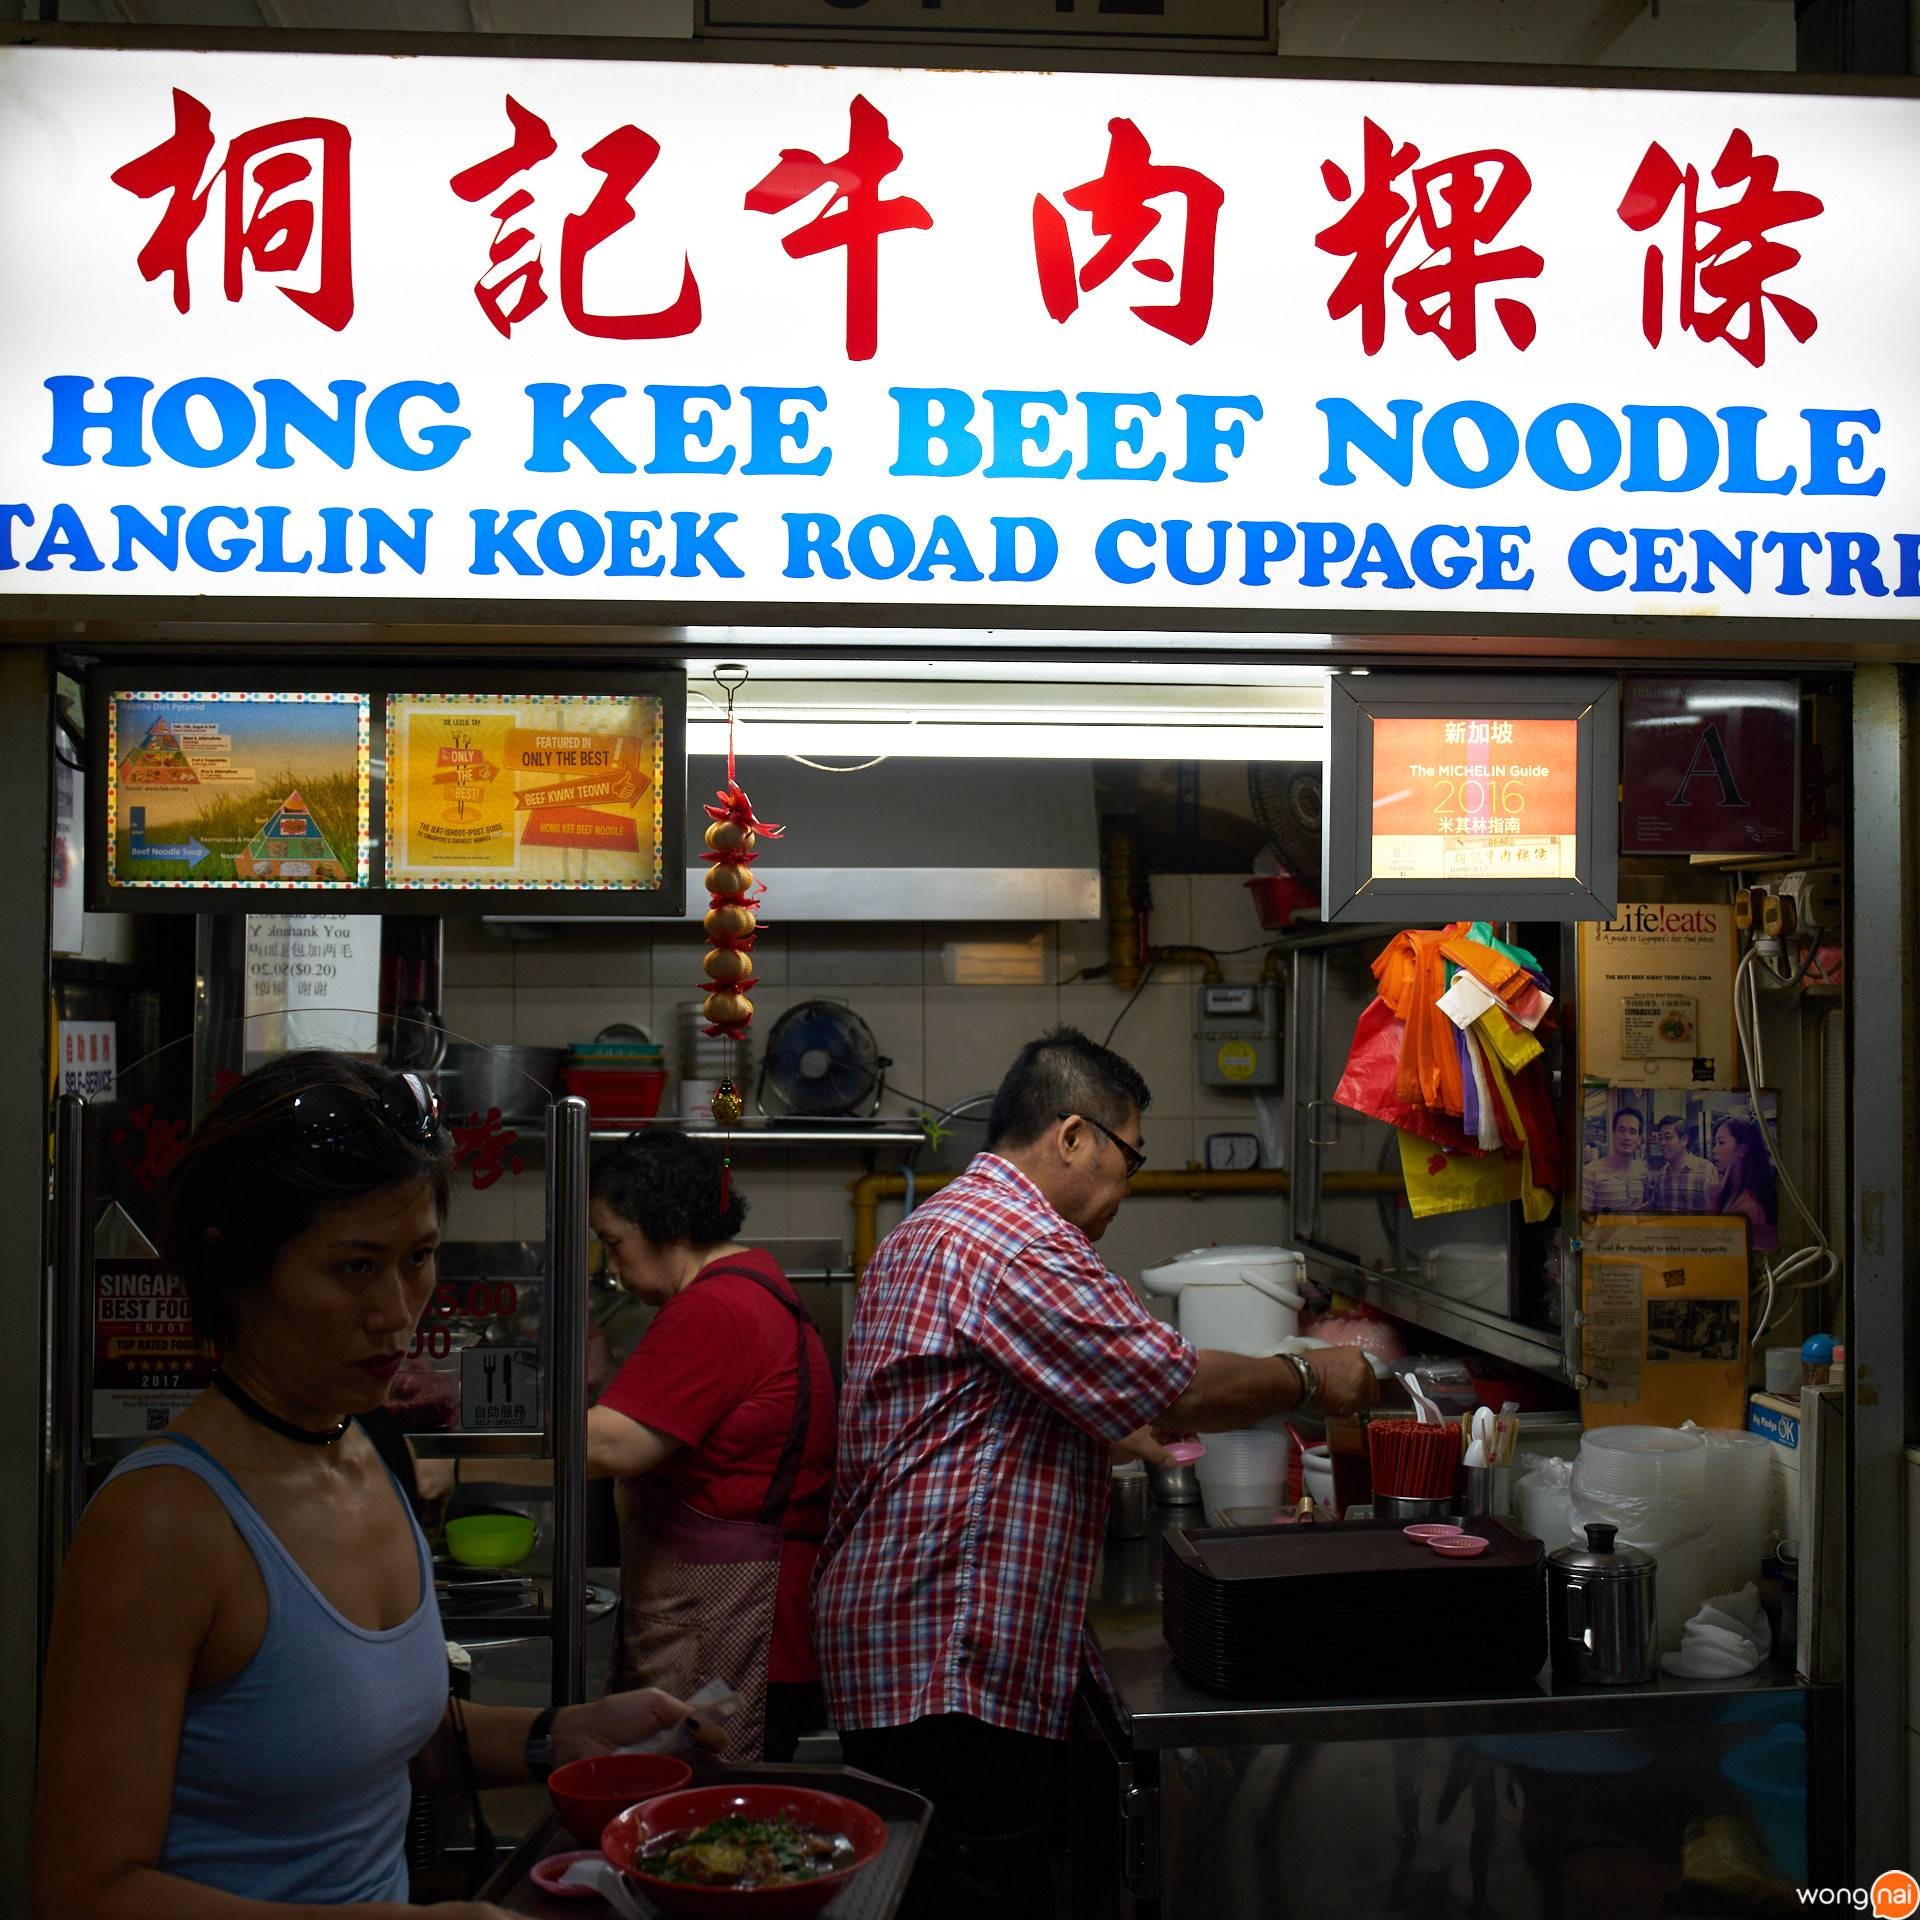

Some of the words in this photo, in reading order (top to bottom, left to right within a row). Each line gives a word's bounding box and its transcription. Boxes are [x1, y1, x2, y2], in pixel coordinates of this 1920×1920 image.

[111, 89, 1824, 368] 桐記牛肉粿條
[42, 376, 471, 471] HONG
[524, 383, 832, 476] KEE
[889, 387, 1263, 483] BEEF
[1316, 398, 1885, 496] NOODLE
[0, 504, 433, 574] TANGLIN
[469, 509, 745, 578] KOEK
[782, 513, 1058, 582] ROAD
[1095, 519, 1534, 590] CUPPAGE
[1444, 720, 1514, 744] 新加坡
[536, 736, 580, 749] FEATURED
[582, 737, 592, 748] IN
[451, 751, 474, 763] ONLY
[522, 751, 552, 767] ONLY
[556, 751, 577, 766] THE
[1666, 722, 1752, 807] A
[456, 769, 473, 782] THE
[1409, 764, 1434, 777] The
[1438, 764, 1506, 777] MICHELIN
[1512, 764, 1549, 777] Guide
[525, 792, 546, 806] BEEF
[548, 788, 575, 803] KWAY
[1433, 780, 1525, 814] 2016
[1438, 817, 1521, 834] 米其林指南
[152, 847, 181, 856] Noodle
[324, 925, 350, 937] You
[102, 1299, 149, 1319] BEST
[155, 1299, 193, 1319] FOO
[135, 1323, 186, 1334] ENJOY
[142, 1375, 181, 1388] 2017
[475, 1404, 527, 1418] 自助服務
[1778, 1418, 1795, 1443] OK
